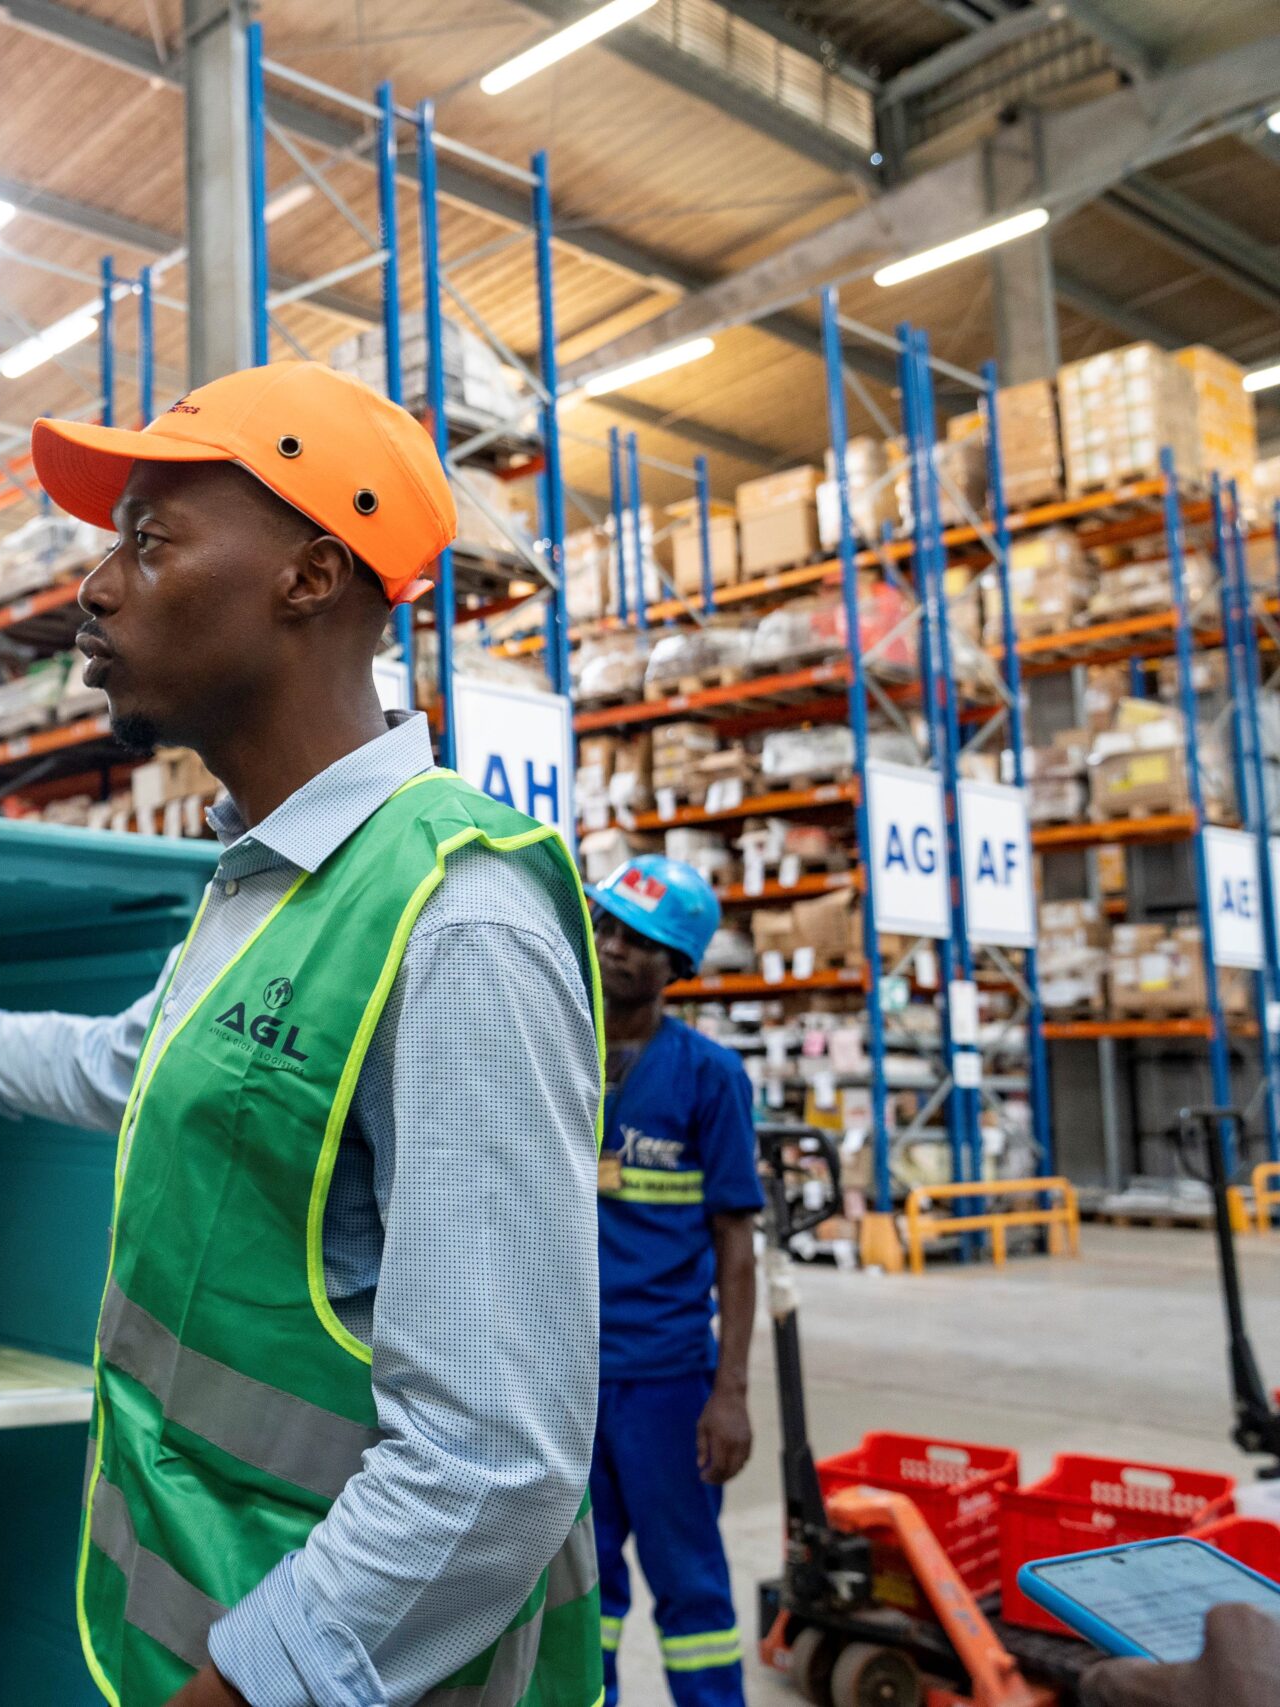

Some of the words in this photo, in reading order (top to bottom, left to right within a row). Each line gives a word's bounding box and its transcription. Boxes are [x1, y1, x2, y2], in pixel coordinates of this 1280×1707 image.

[482, 753, 560, 824] AH
[884, 823, 936, 875] AG
[976, 838, 1017, 885] AF
[1221, 878, 1252, 918] AE
[214, 1001, 310, 1063] AGL
